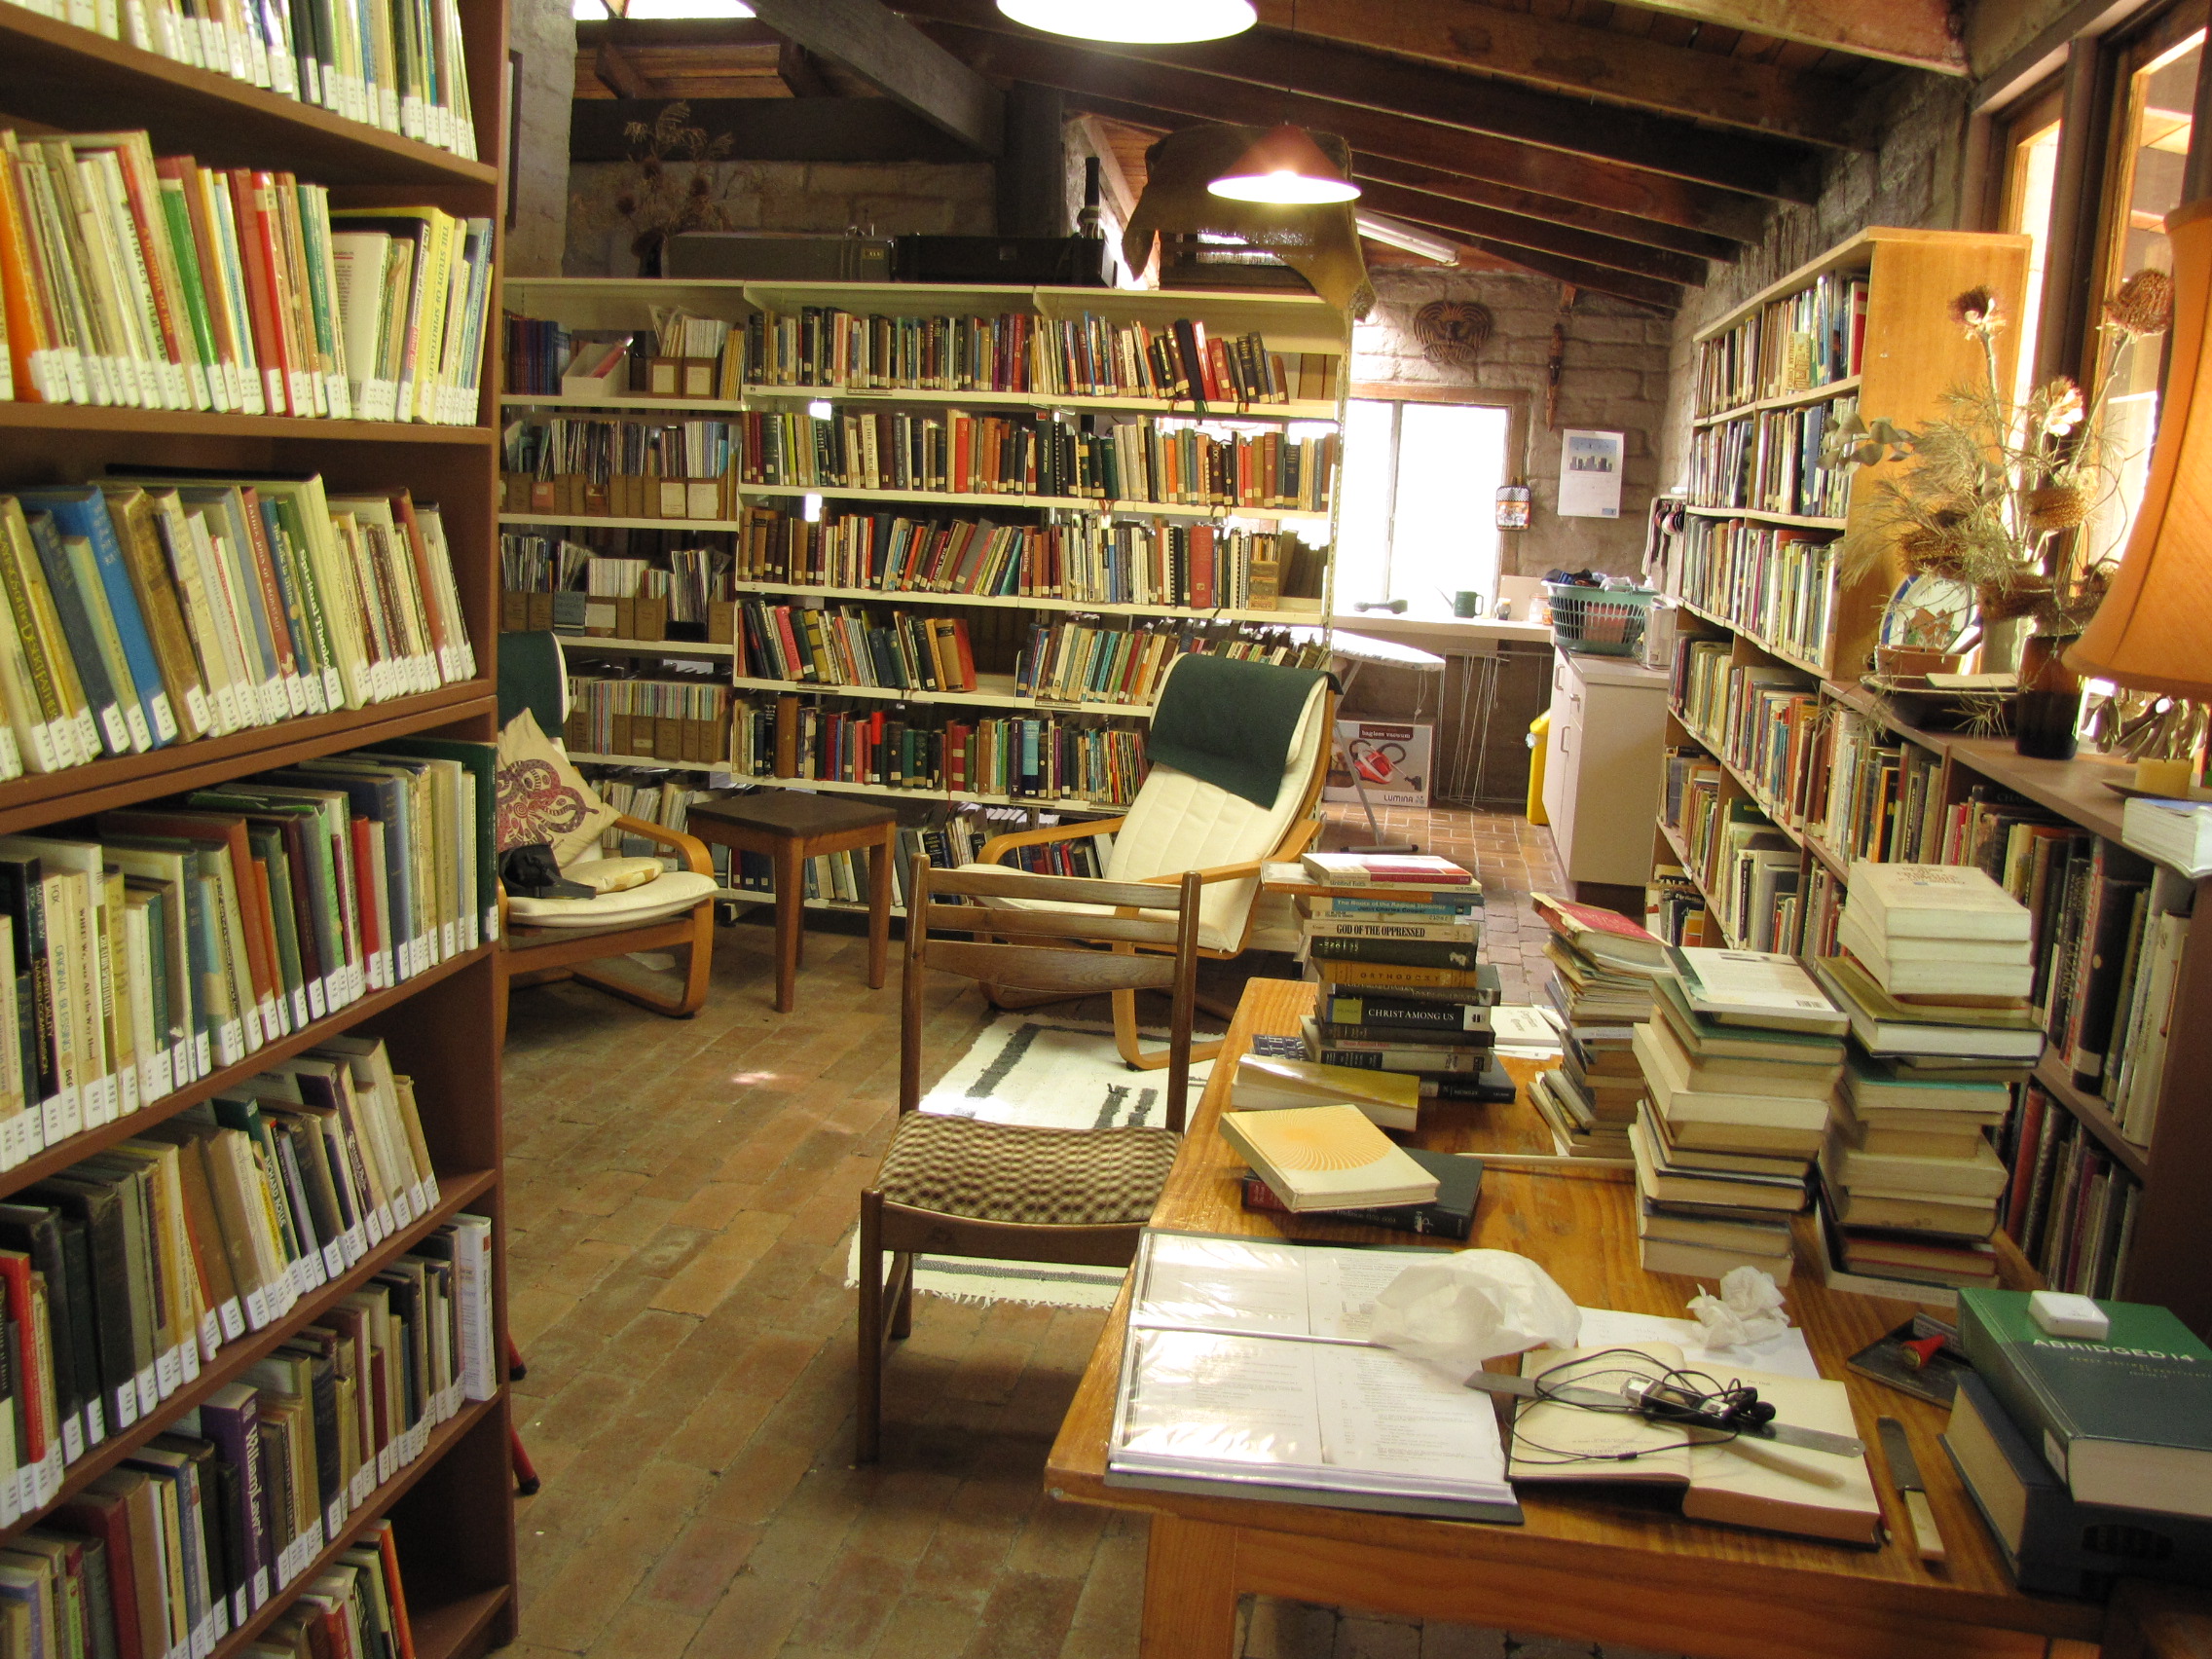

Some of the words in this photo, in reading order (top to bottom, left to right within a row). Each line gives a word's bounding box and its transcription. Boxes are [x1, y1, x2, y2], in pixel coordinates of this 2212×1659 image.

[440, 225, 449, 248] THE
[126, 217, 148, 286] INTIMACY
[145, 294, 159, 328] WITH
[437, 251, 447, 287] STUDY
[435, 290, 443, 307] OF
[296, 549, 321, 616] Spiritual
[313, 616, 334, 673] Theolog
[35, 669, 61, 722] FATHER
[51, 884, 60, 903] FOX
[1336, 925, 1351, 935] GOD
[1353, 925, 1363, 935] OF
[1364, 925, 1381, 937] THE
[1381, 926, 1425, 938] OPPRESSED
[55, 945, 66, 994] ORIGINAL
[1360, 973, 1441, 982] ORTHODOXY
[59, 999, 72, 1051] BLESSING
[1368, 1009, 1405, 1018] CHRIST
[1405, 1011, 1440, 1020] AMONG
[264, 1155, 279, 1198] RICHARD
[274, 1198, 287, 1228] ROLLE
[2033, 1339, 2167, 1359] ABRIDGED
[2169, 1352, 2195, 1363] 14
[245, 1423, 260, 1493] William
